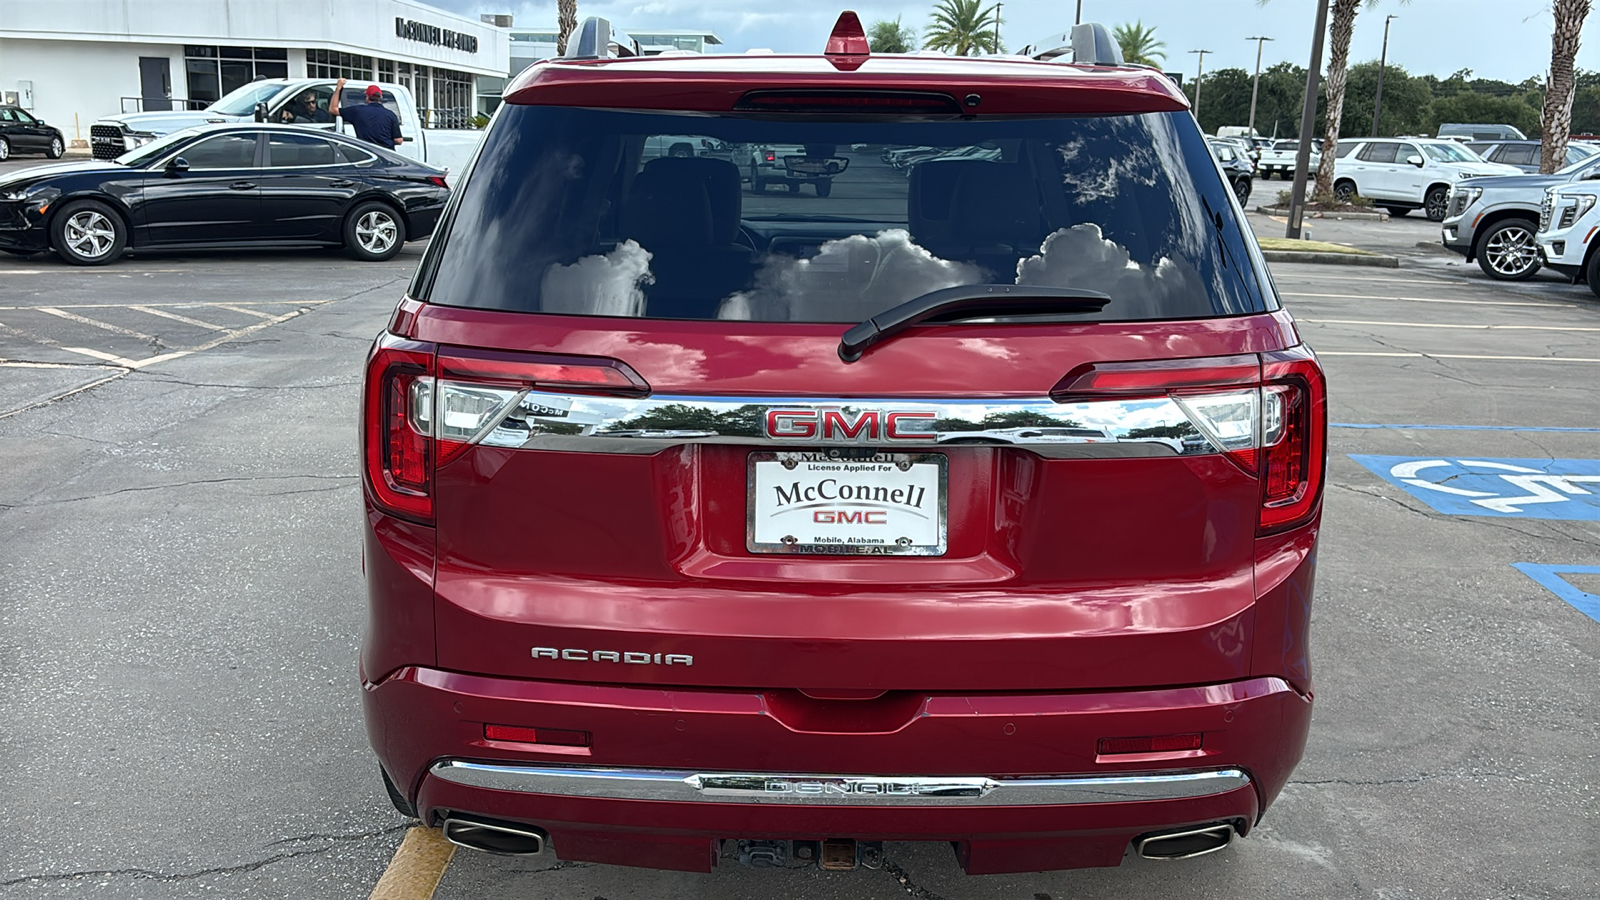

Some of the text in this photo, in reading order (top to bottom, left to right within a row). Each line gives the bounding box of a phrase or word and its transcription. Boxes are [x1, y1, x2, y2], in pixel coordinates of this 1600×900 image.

[766, 408, 938, 442] GMC
[808, 464, 841, 472] License
[843, 464, 876, 473] Applied
[773, 478, 926, 509] McConnell
[813, 510, 888, 525] GMC
[814, 536, 845, 545] Mobile,
[531, 646, 694, 667] ACADIA
[764, 780, 920, 796] DENALI
